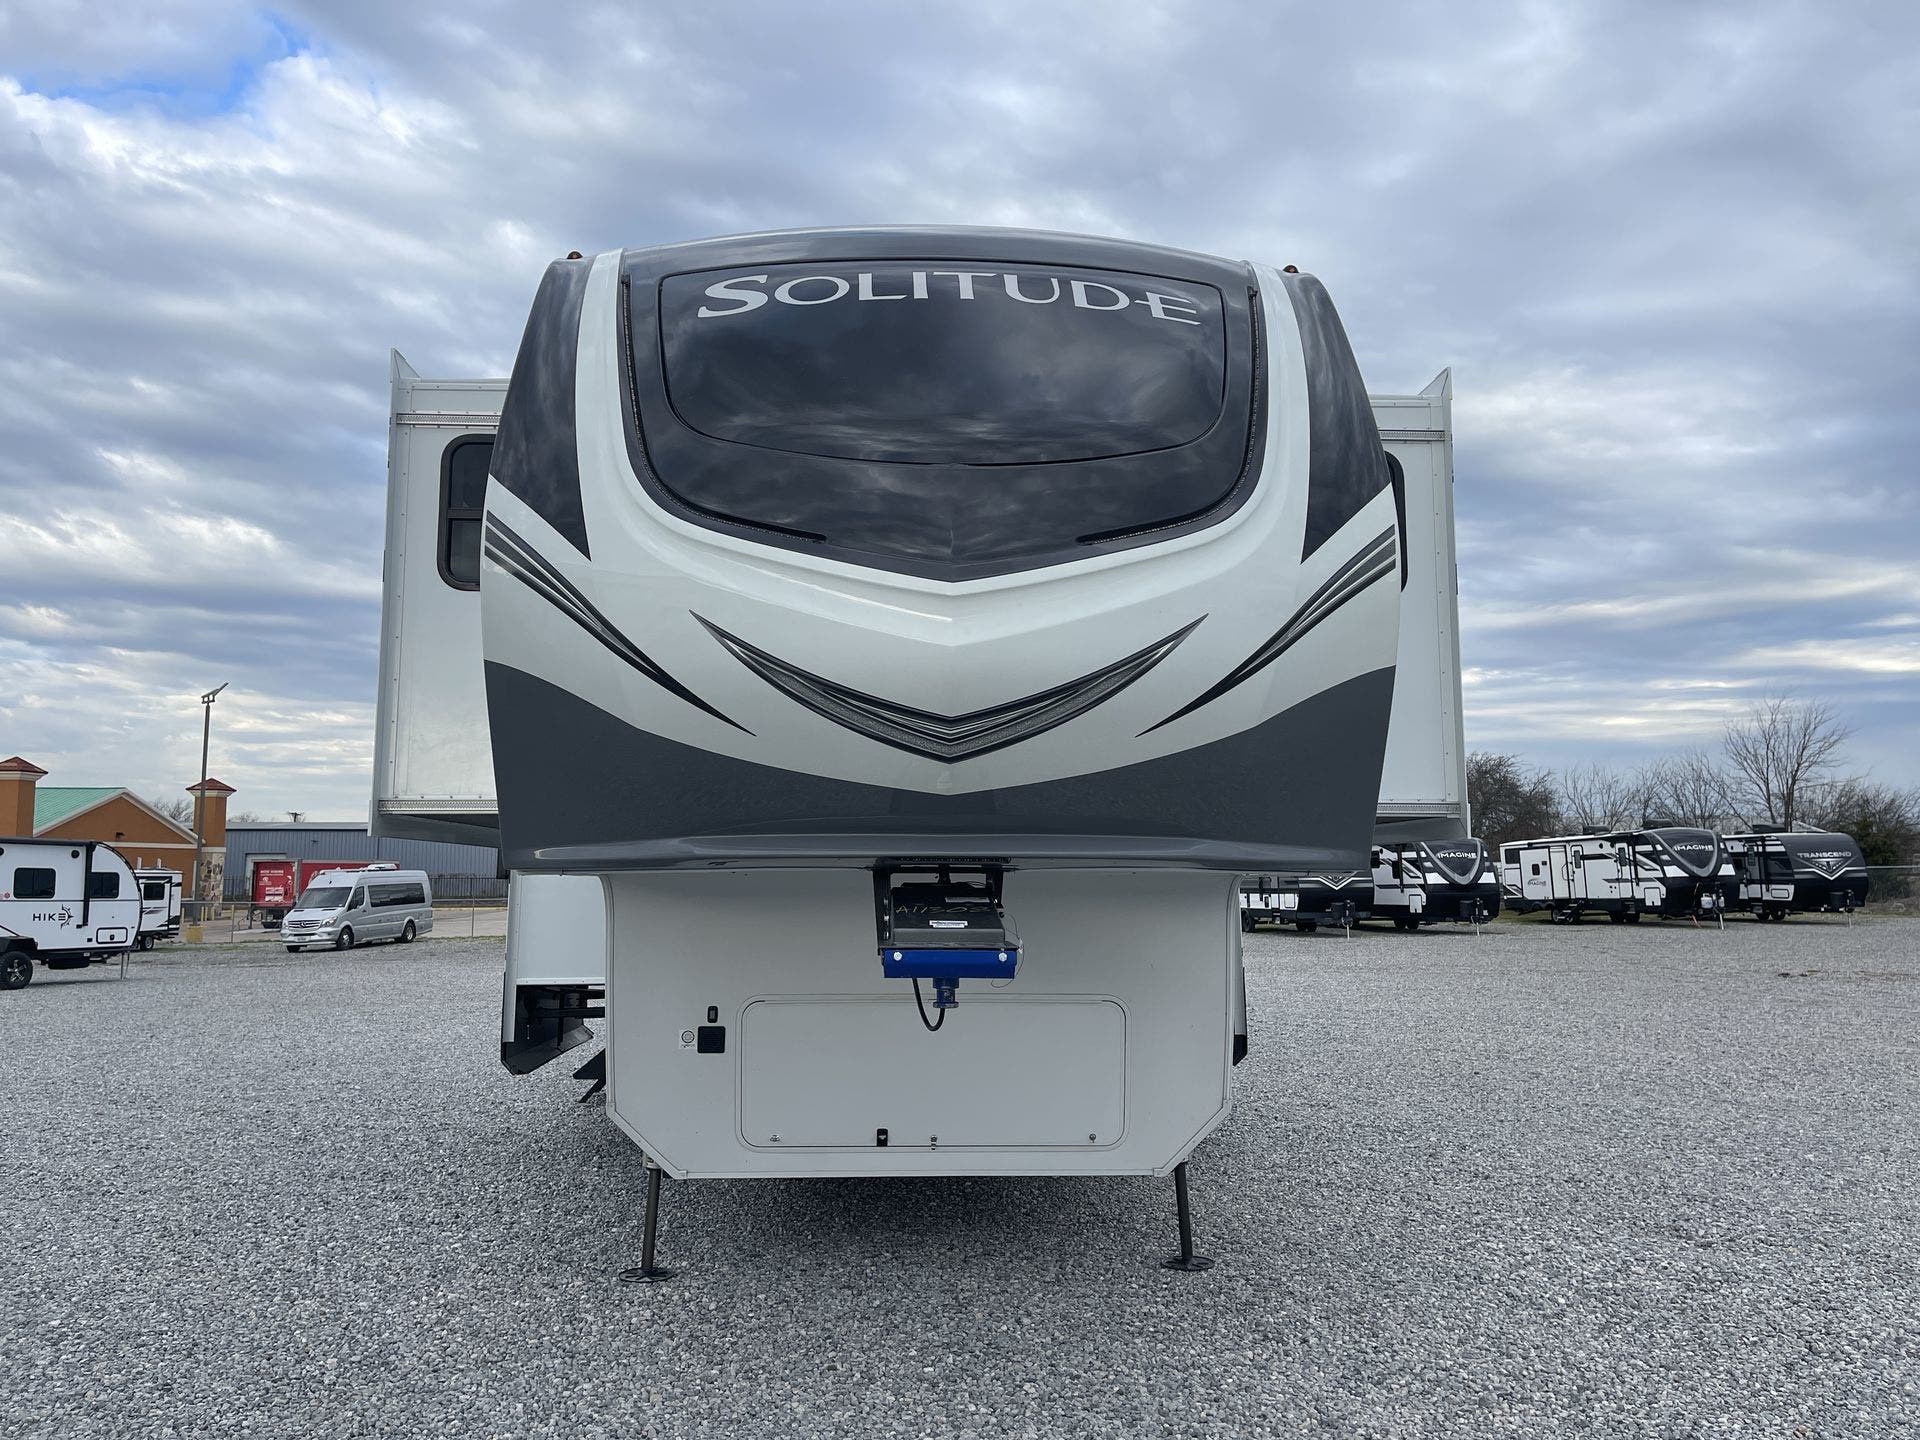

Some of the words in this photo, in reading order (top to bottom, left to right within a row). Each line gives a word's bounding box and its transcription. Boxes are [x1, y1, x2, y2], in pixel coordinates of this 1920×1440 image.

[697, 271, 1202, 326] SOLITUDE
[1673, 844, 1714, 852] IMAGINE
[32, 912, 67, 922] HIKE
